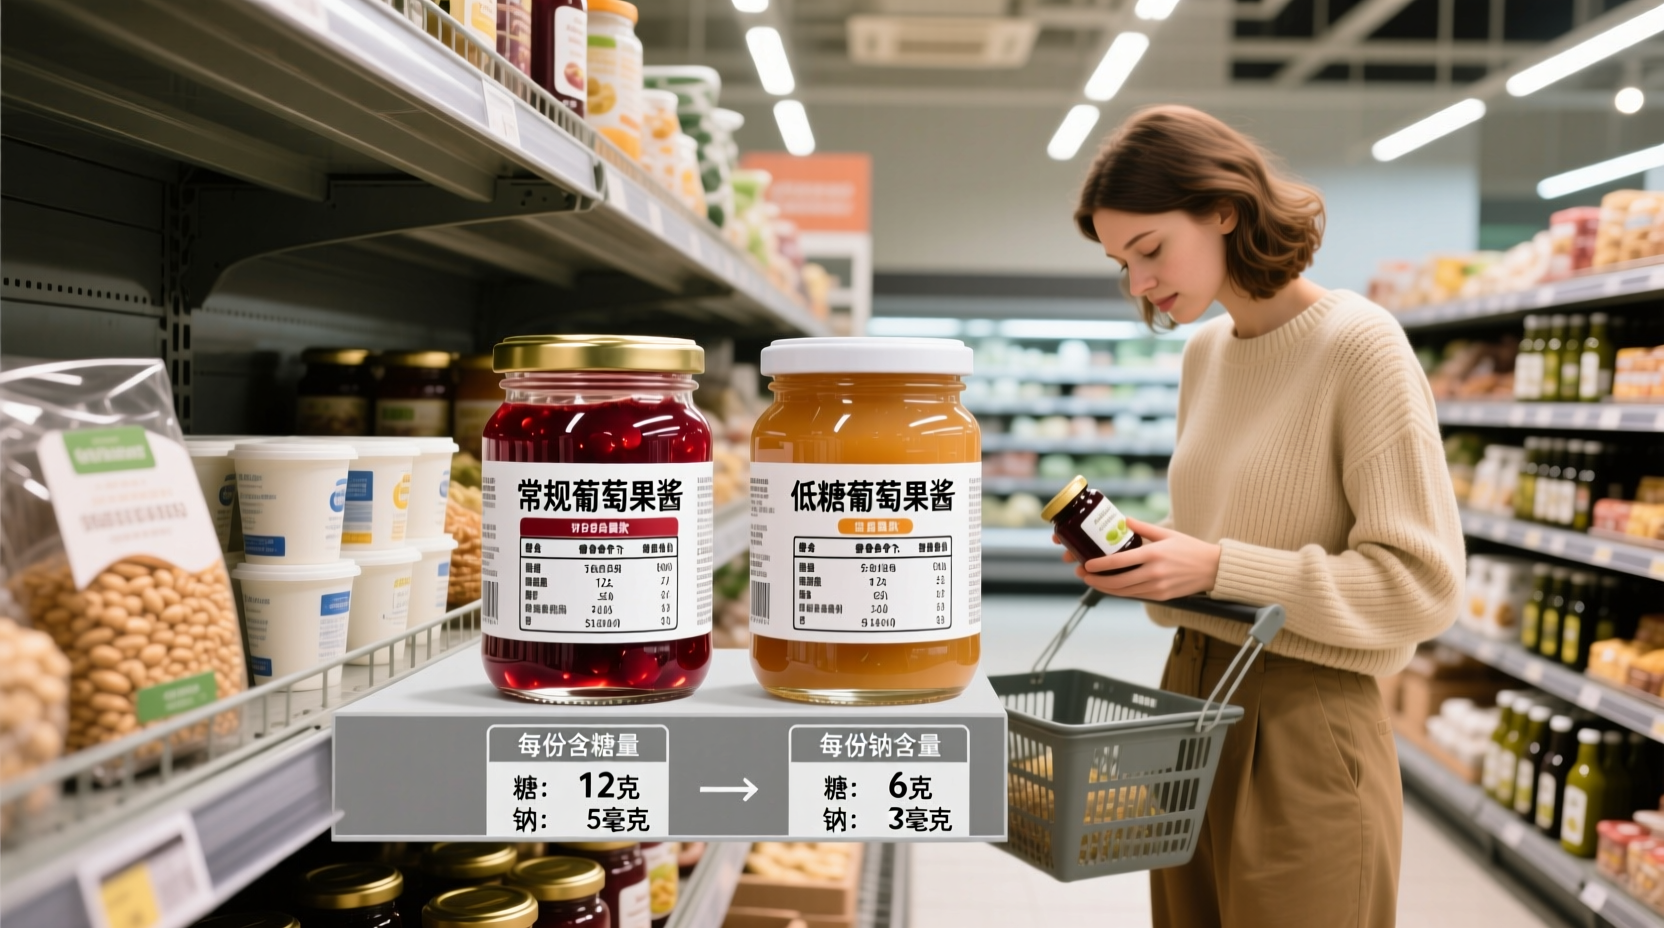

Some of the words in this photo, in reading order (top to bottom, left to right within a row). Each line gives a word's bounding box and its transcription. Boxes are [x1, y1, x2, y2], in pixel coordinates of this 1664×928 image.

[518, 479, 684, 512] 常规葡萄果酱
[791, 479, 956, 512] 低糖葡萄果酱
[518, 732, 640, 758] 每份含糖量
[819, 732, 941, 758] 每份钠含量
[579, 771, 640, 801] 12克
[888, 771, 933, 801] 6克
[587, 806, 650, 833] 5毫克
[888, 805, 953, 833] 3毫克
